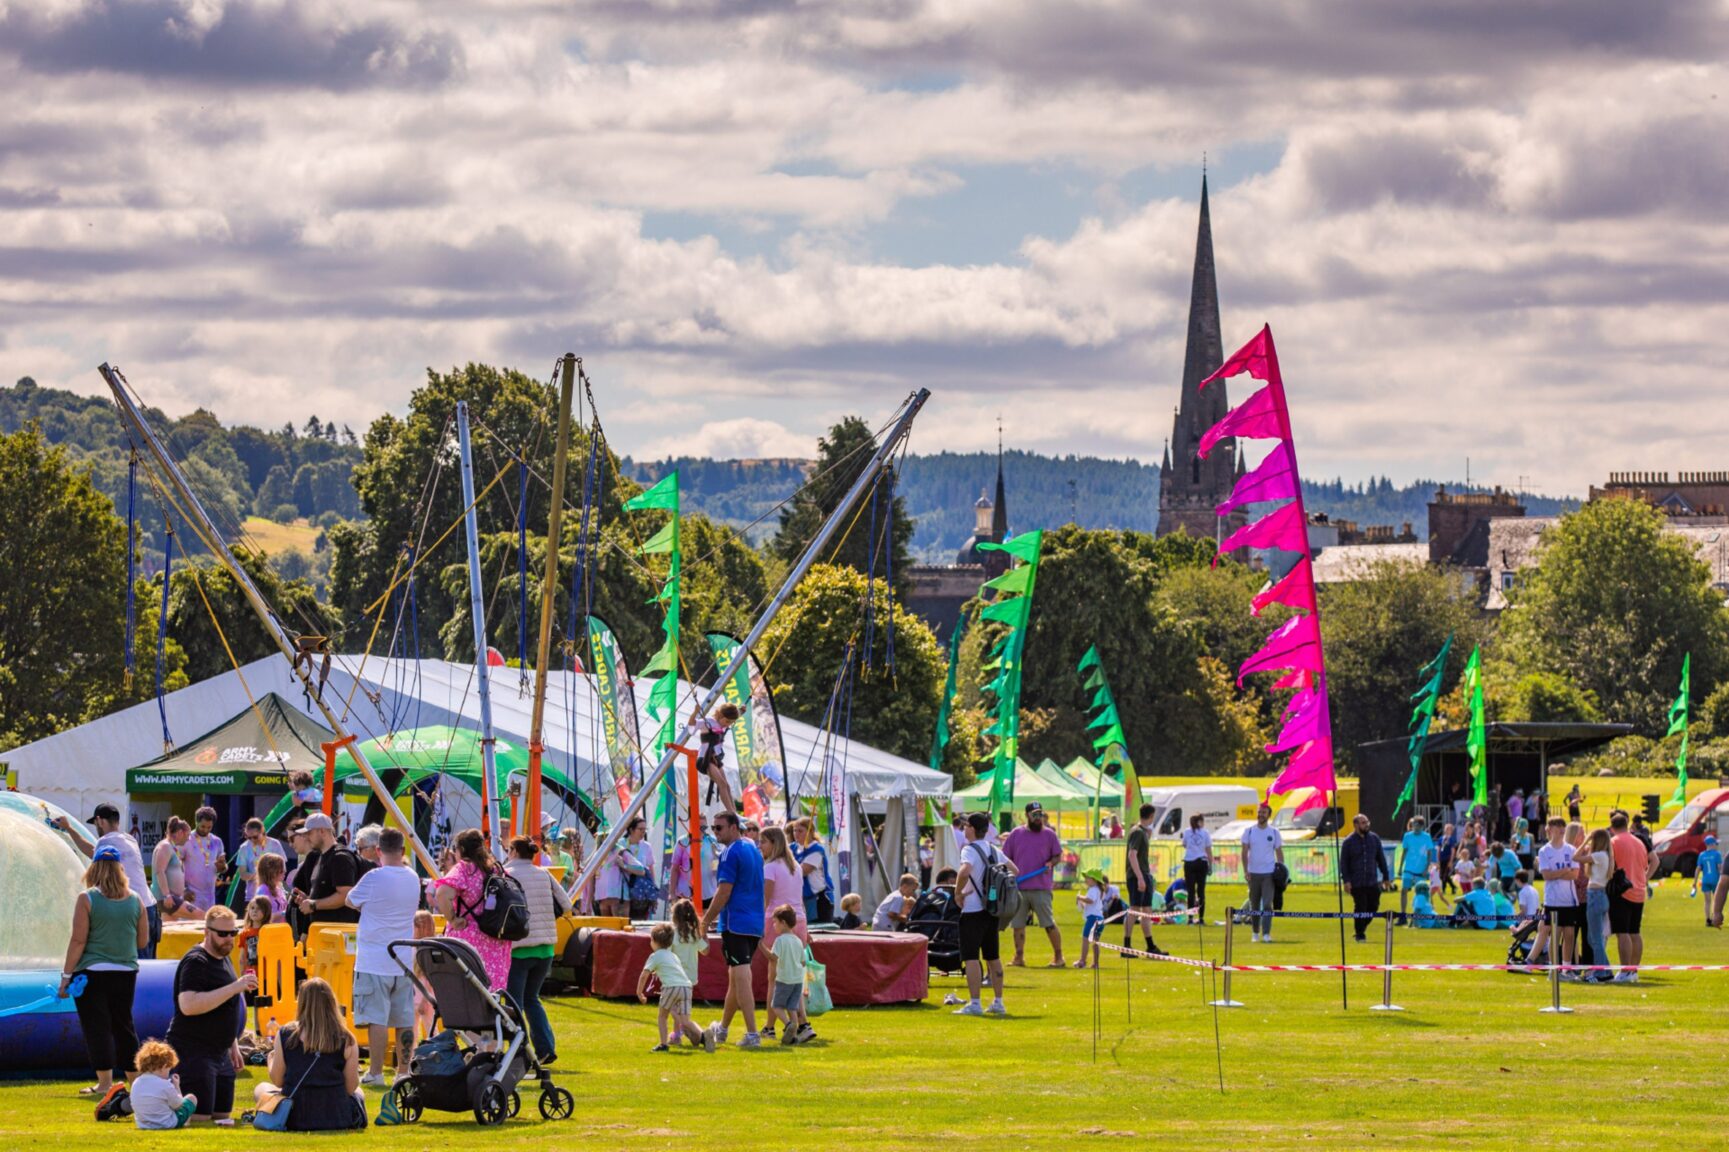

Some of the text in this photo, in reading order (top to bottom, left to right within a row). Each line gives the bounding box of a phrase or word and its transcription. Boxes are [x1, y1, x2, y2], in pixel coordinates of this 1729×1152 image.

[221, 746, 257, 756] ARMY
[220, 752, 264, 761] CADETS
[134, 775, 235, 784] WWW.ARMYCADETS.COM
[254, 775, 281, 785] GOING
